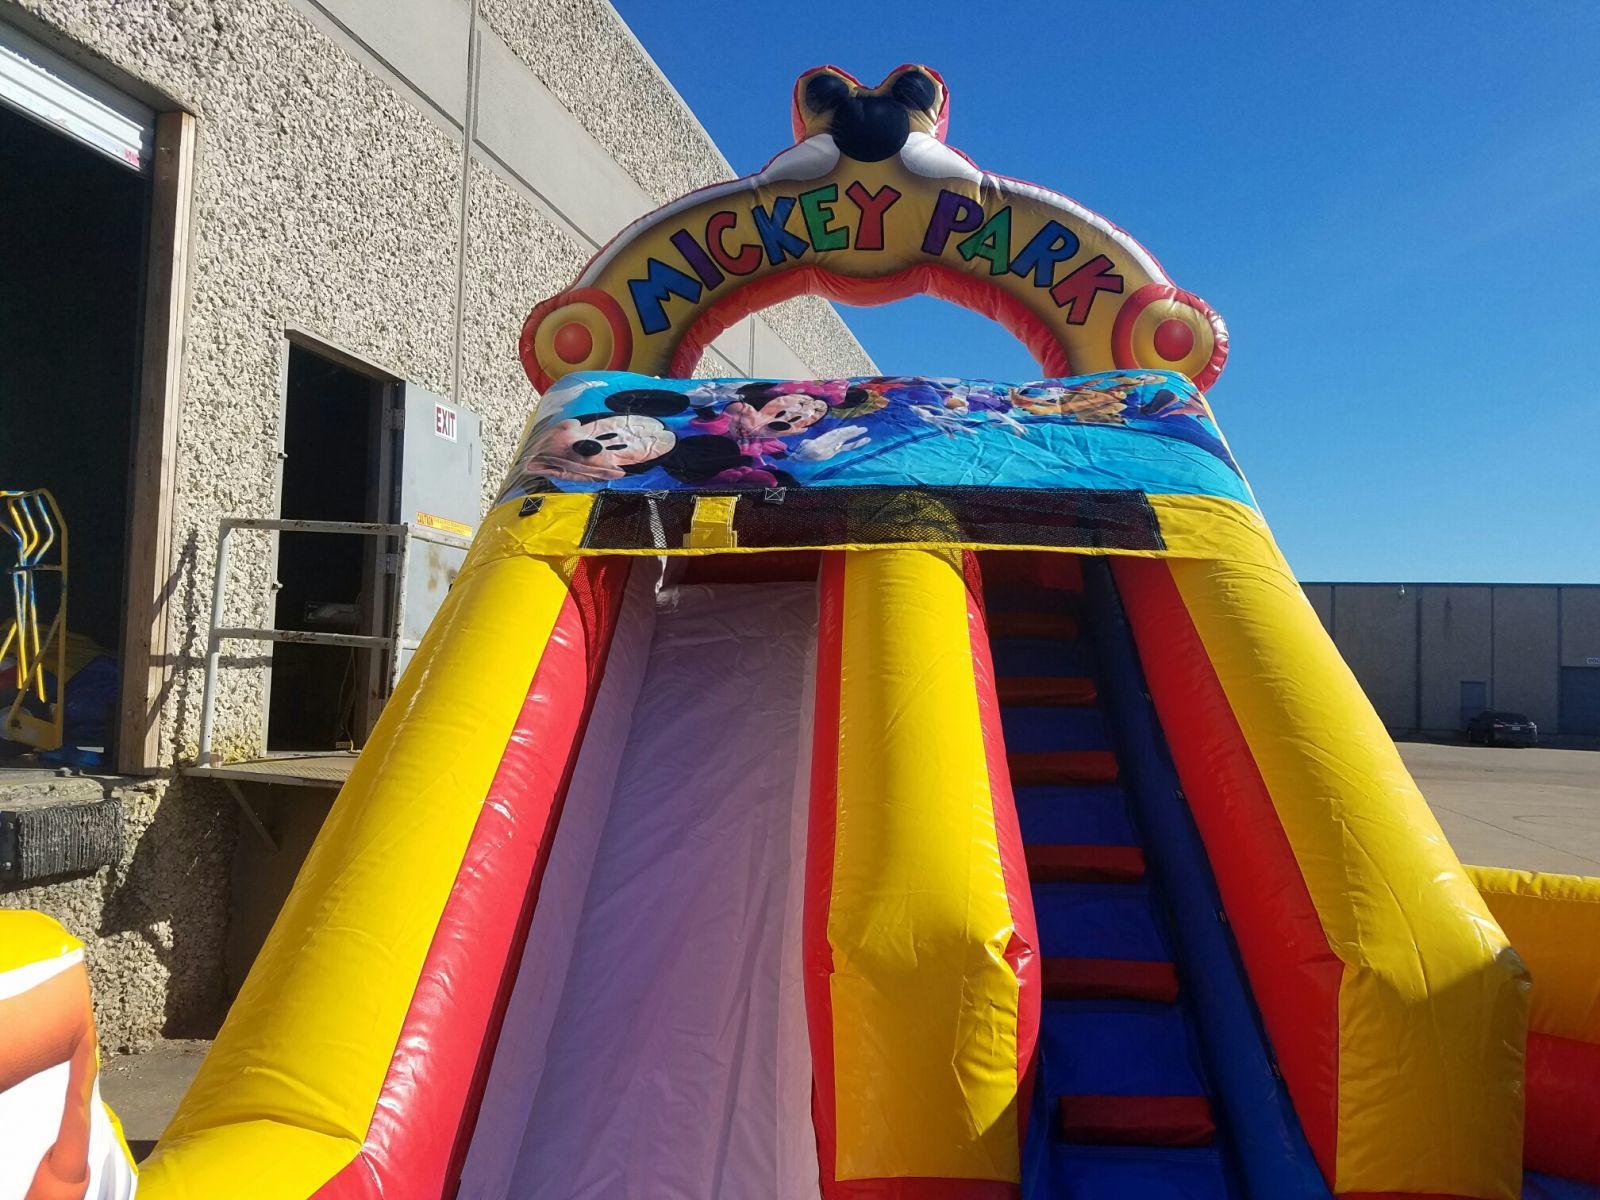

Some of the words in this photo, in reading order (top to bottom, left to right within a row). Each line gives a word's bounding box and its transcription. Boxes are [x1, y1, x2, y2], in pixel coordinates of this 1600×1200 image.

[627, 180, 901, 335] MICKEY
[921, 189, 1124, 325] PARK
[436, 406, 456, 438] EXIT
